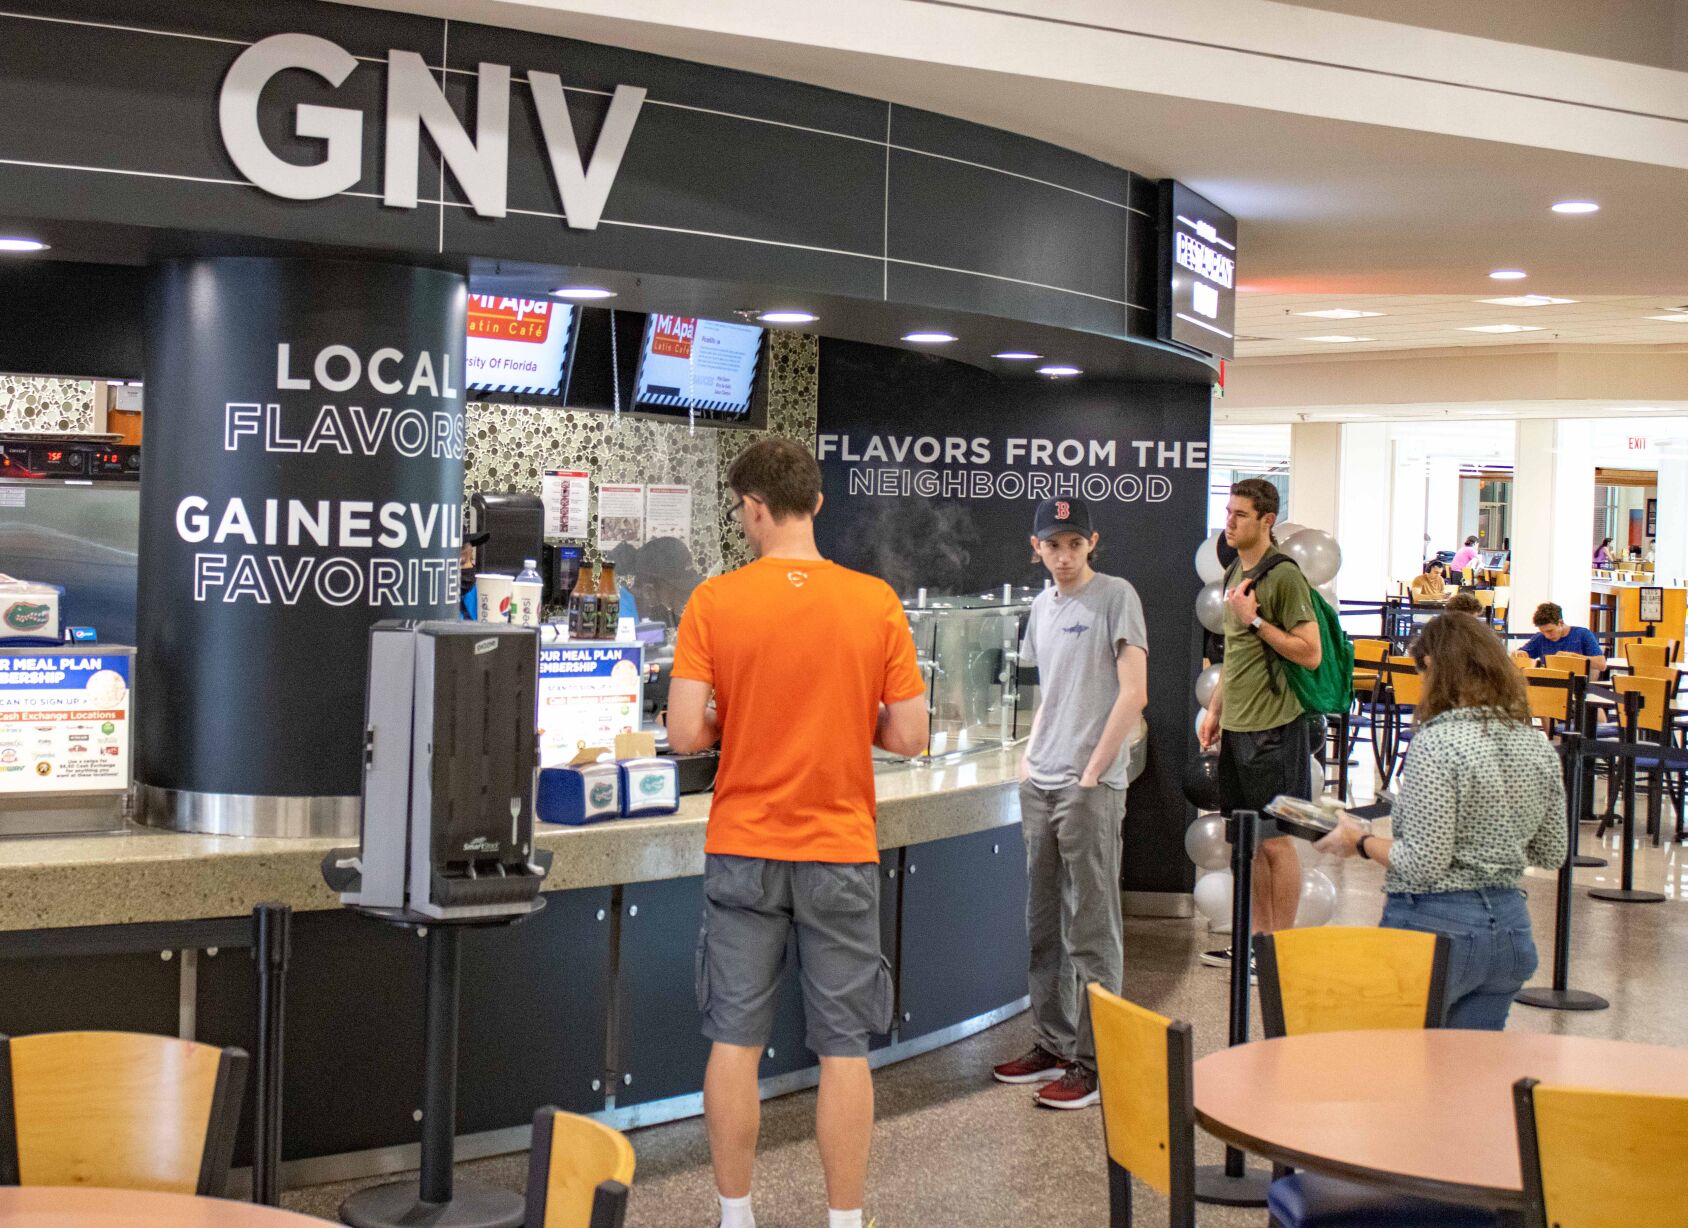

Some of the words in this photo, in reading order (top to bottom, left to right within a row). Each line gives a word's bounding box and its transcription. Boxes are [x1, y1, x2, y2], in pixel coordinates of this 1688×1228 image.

[219, 33, 648, 230] GNV
[509, 322, 543, 337] Café
[277, 343, 458, 399] LOCAL
[489, 357, 502, 368] Of
[504, 359, 537, 372] Florida
[224, 403, 464, 460] FLAVORS
[818, 434, 991, 465] FLAVORS
[1006, 438, 1116, 467] FROM
[1132, 441, 1208, 469] THE
[1628, 437, 1646, 450] EXIT
[849, 468, 1172, 502] NEIGHBORHOOD
[1055, 501, 1070, 520] B
[194, 553, 461, 606] FAVORITE
[13, 658, 57, 670] MEAL
[60, 658, 102, 670] PLAN
[563, 650, 592, 661] MEAL
[594, 650, 622, 660] PLAN
[22, 712, 67, 721] Exchange
[71, 711, 116, 719] Locations
